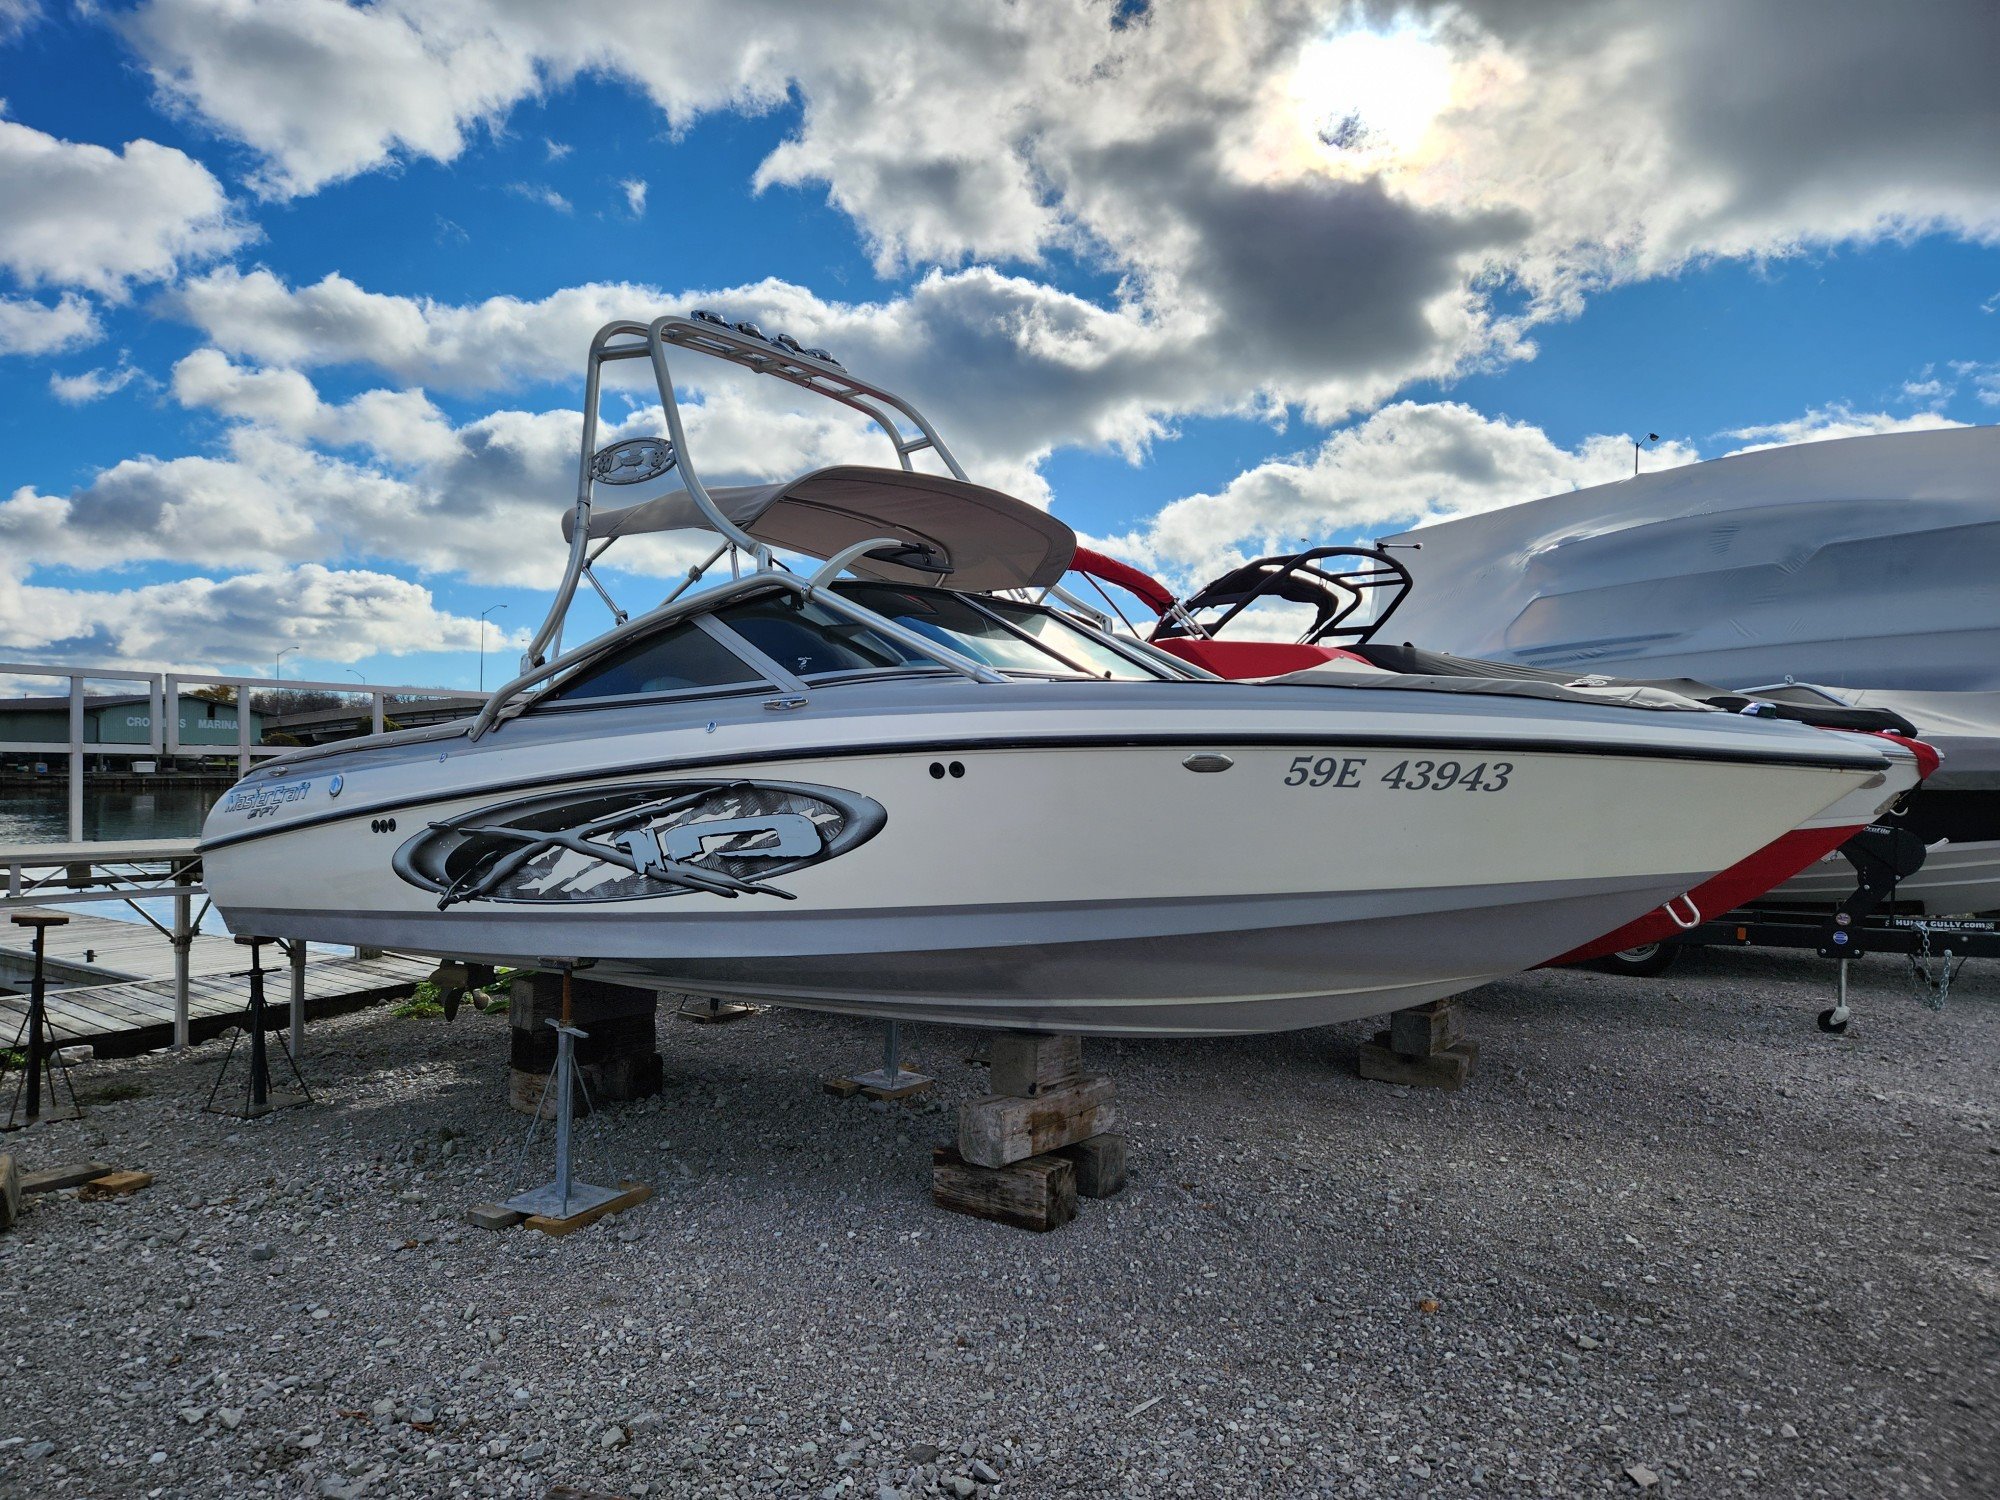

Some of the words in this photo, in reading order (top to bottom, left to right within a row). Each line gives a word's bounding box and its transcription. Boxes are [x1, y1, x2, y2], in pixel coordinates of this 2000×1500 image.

[198, 719, 239, 730] MARINA
[1284, 755, 1367, 788] 59E
[1380, 760, 1514, 792] 43943
[1930, 920, 1985, 929] GULLY.com
